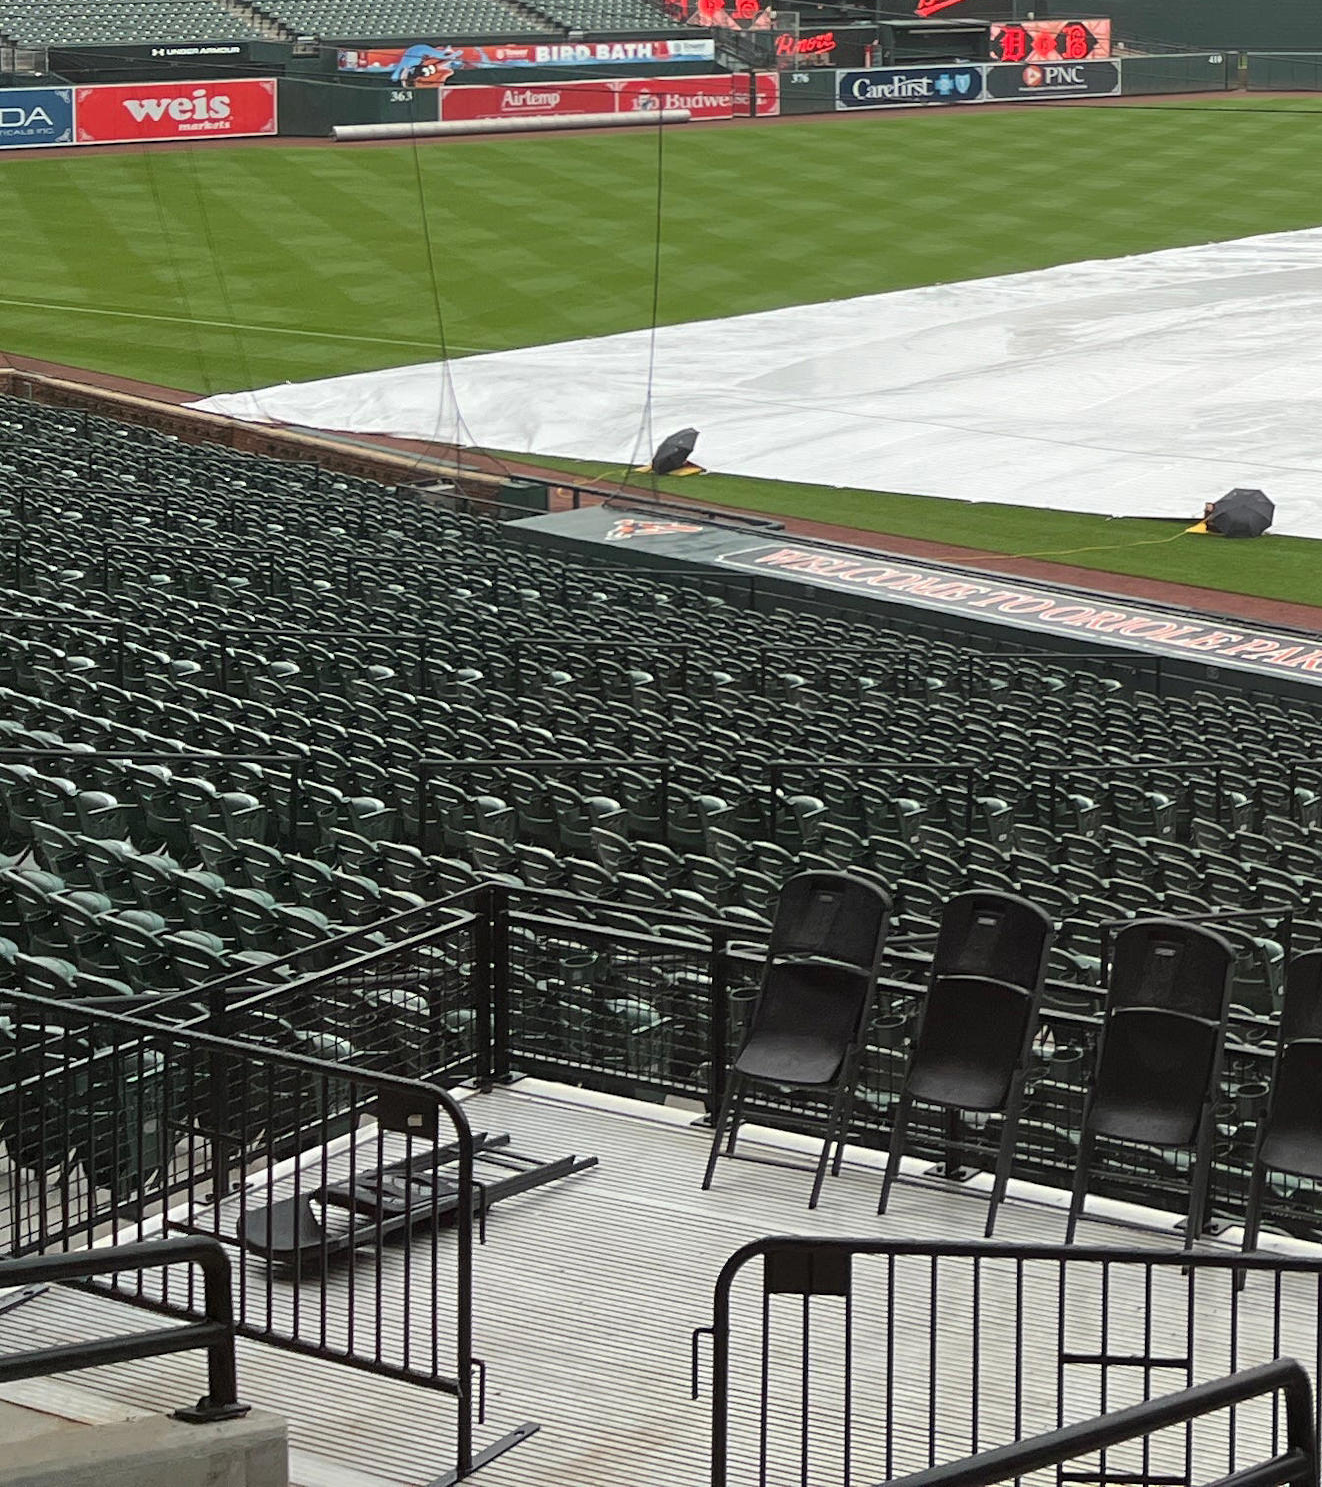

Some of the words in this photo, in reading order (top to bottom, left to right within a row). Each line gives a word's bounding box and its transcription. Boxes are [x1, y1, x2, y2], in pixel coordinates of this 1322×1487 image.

[535, 44, 591, 62] BIRD
[603, 42, 654, 60] BATH
[1044, 66, 1085, 85] PNC
[390, 91, 414, 102] 363
[851, 76, 934, 100] CareFirst
[123, 89, 231, 123] weis
[502, 89, 561, 107] Airtemp
[178, 120, 231, 132] markets
[754, 547, 988, 602] WELCOME
[977, 589, 1056, 617] TO
[1042, 606, 1238, 653] ORIOLE
